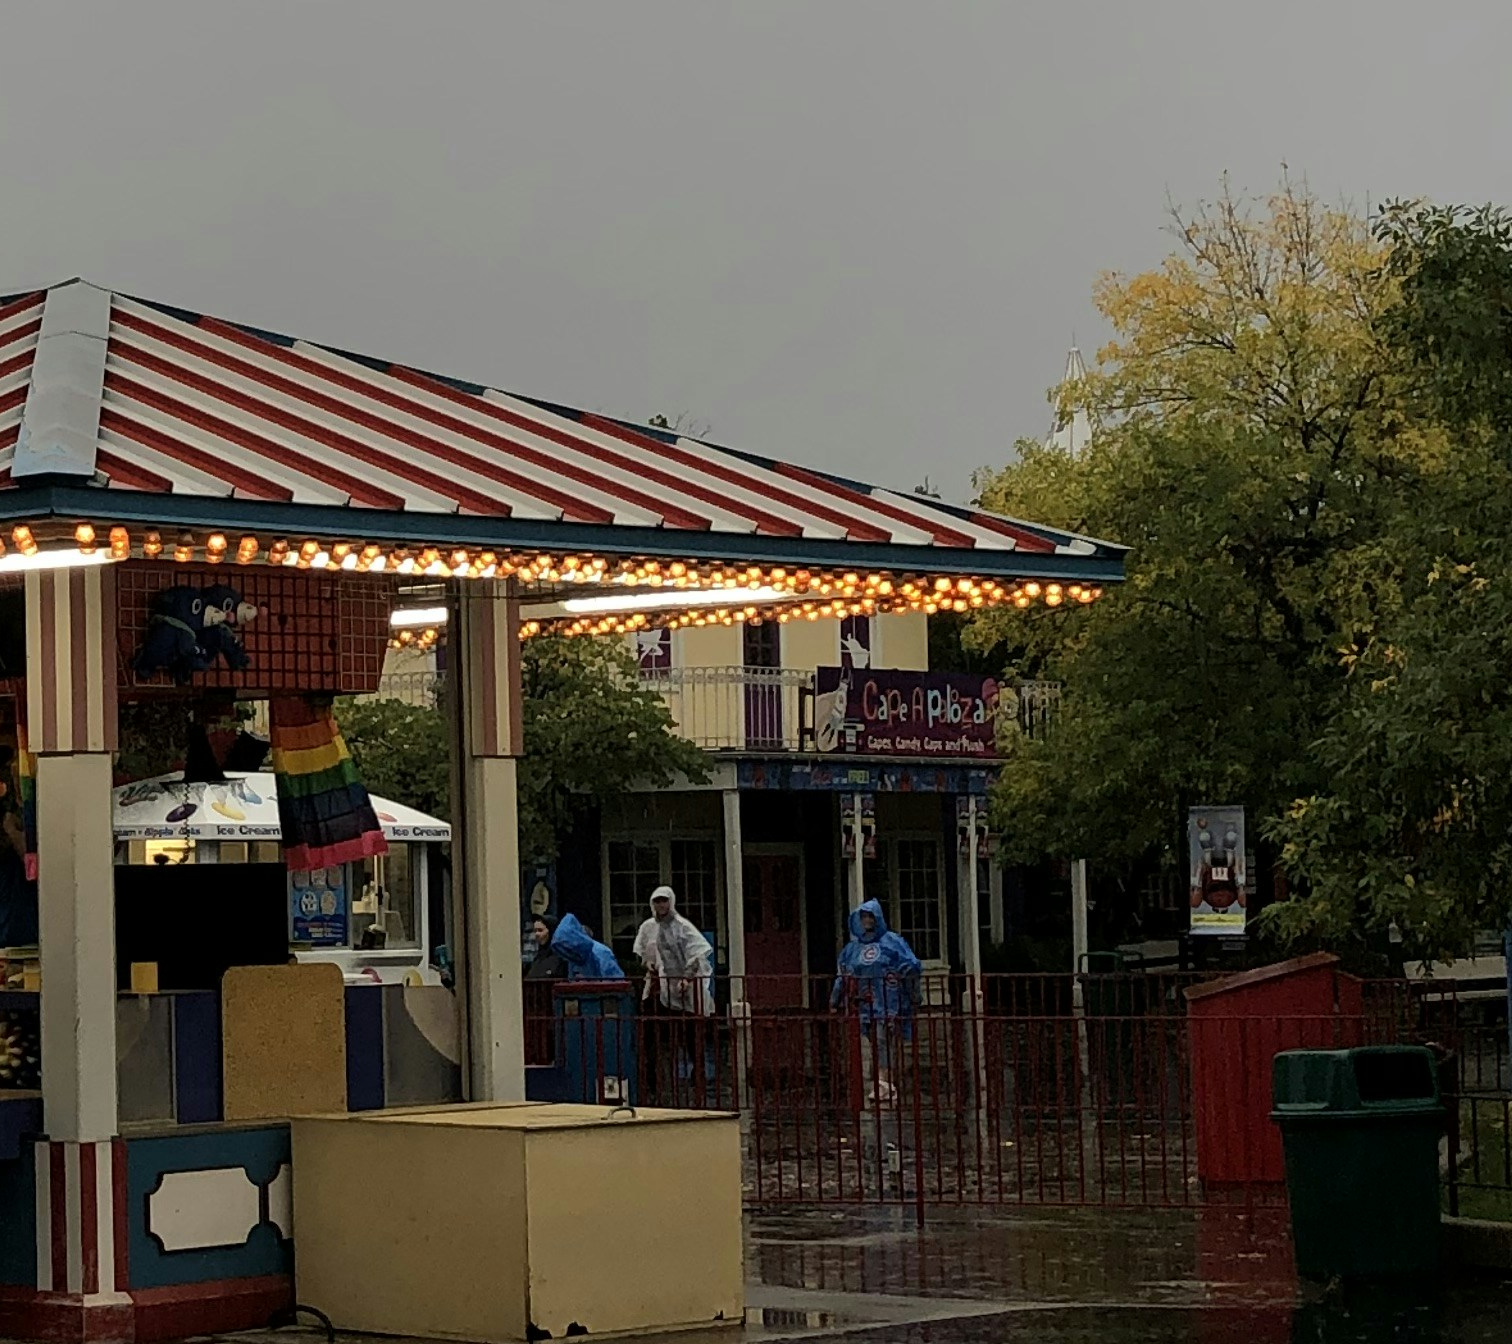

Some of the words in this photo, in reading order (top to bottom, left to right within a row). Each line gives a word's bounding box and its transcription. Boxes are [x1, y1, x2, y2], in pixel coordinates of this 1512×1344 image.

[912, 686, 924, 723] A
[217, 825, 235, 835] Ice
[239, 825, 280, 835] Cream
[392, 826, 409, 836] Ice
[412, 827, 449, 836] Cream
